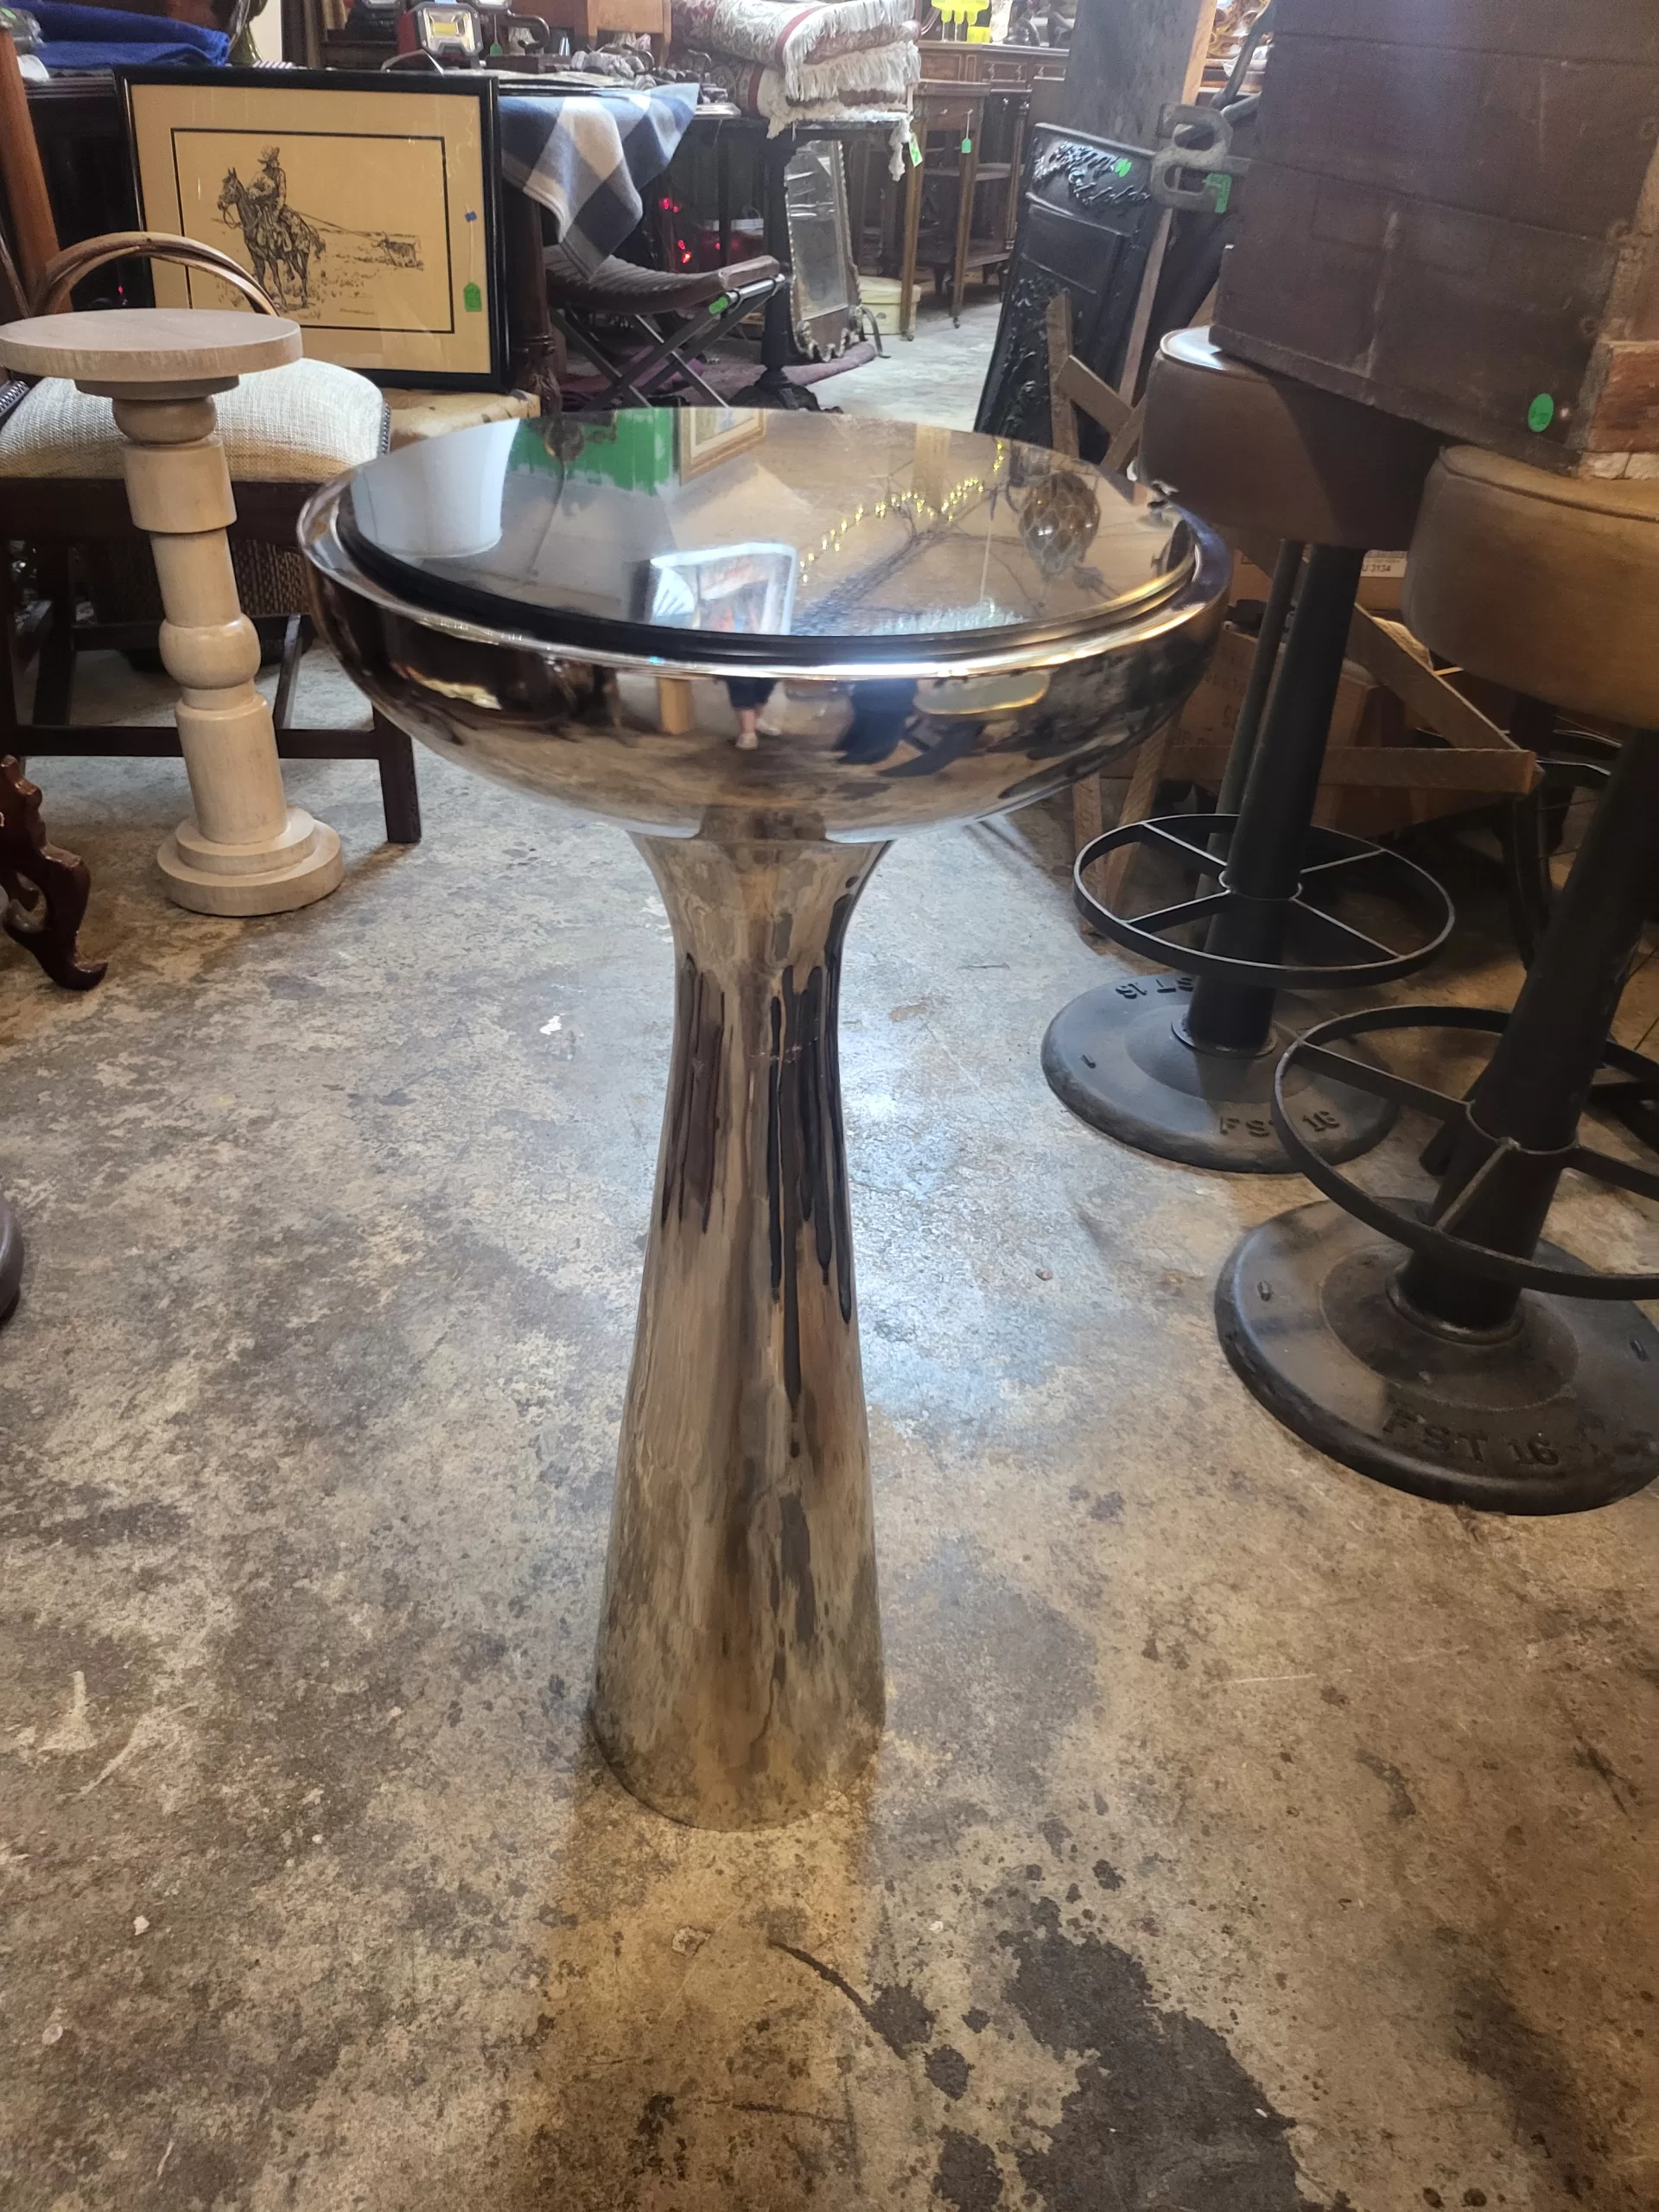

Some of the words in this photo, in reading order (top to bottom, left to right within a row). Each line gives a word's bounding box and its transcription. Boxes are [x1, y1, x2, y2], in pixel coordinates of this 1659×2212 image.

[1219, 1116, 1274, 1138] FS
[1302, 1110, 1340, 1133] 16
[1382, 1406, 1489, 1463] FST
[1509, 1433, 1561, 1466] 16
